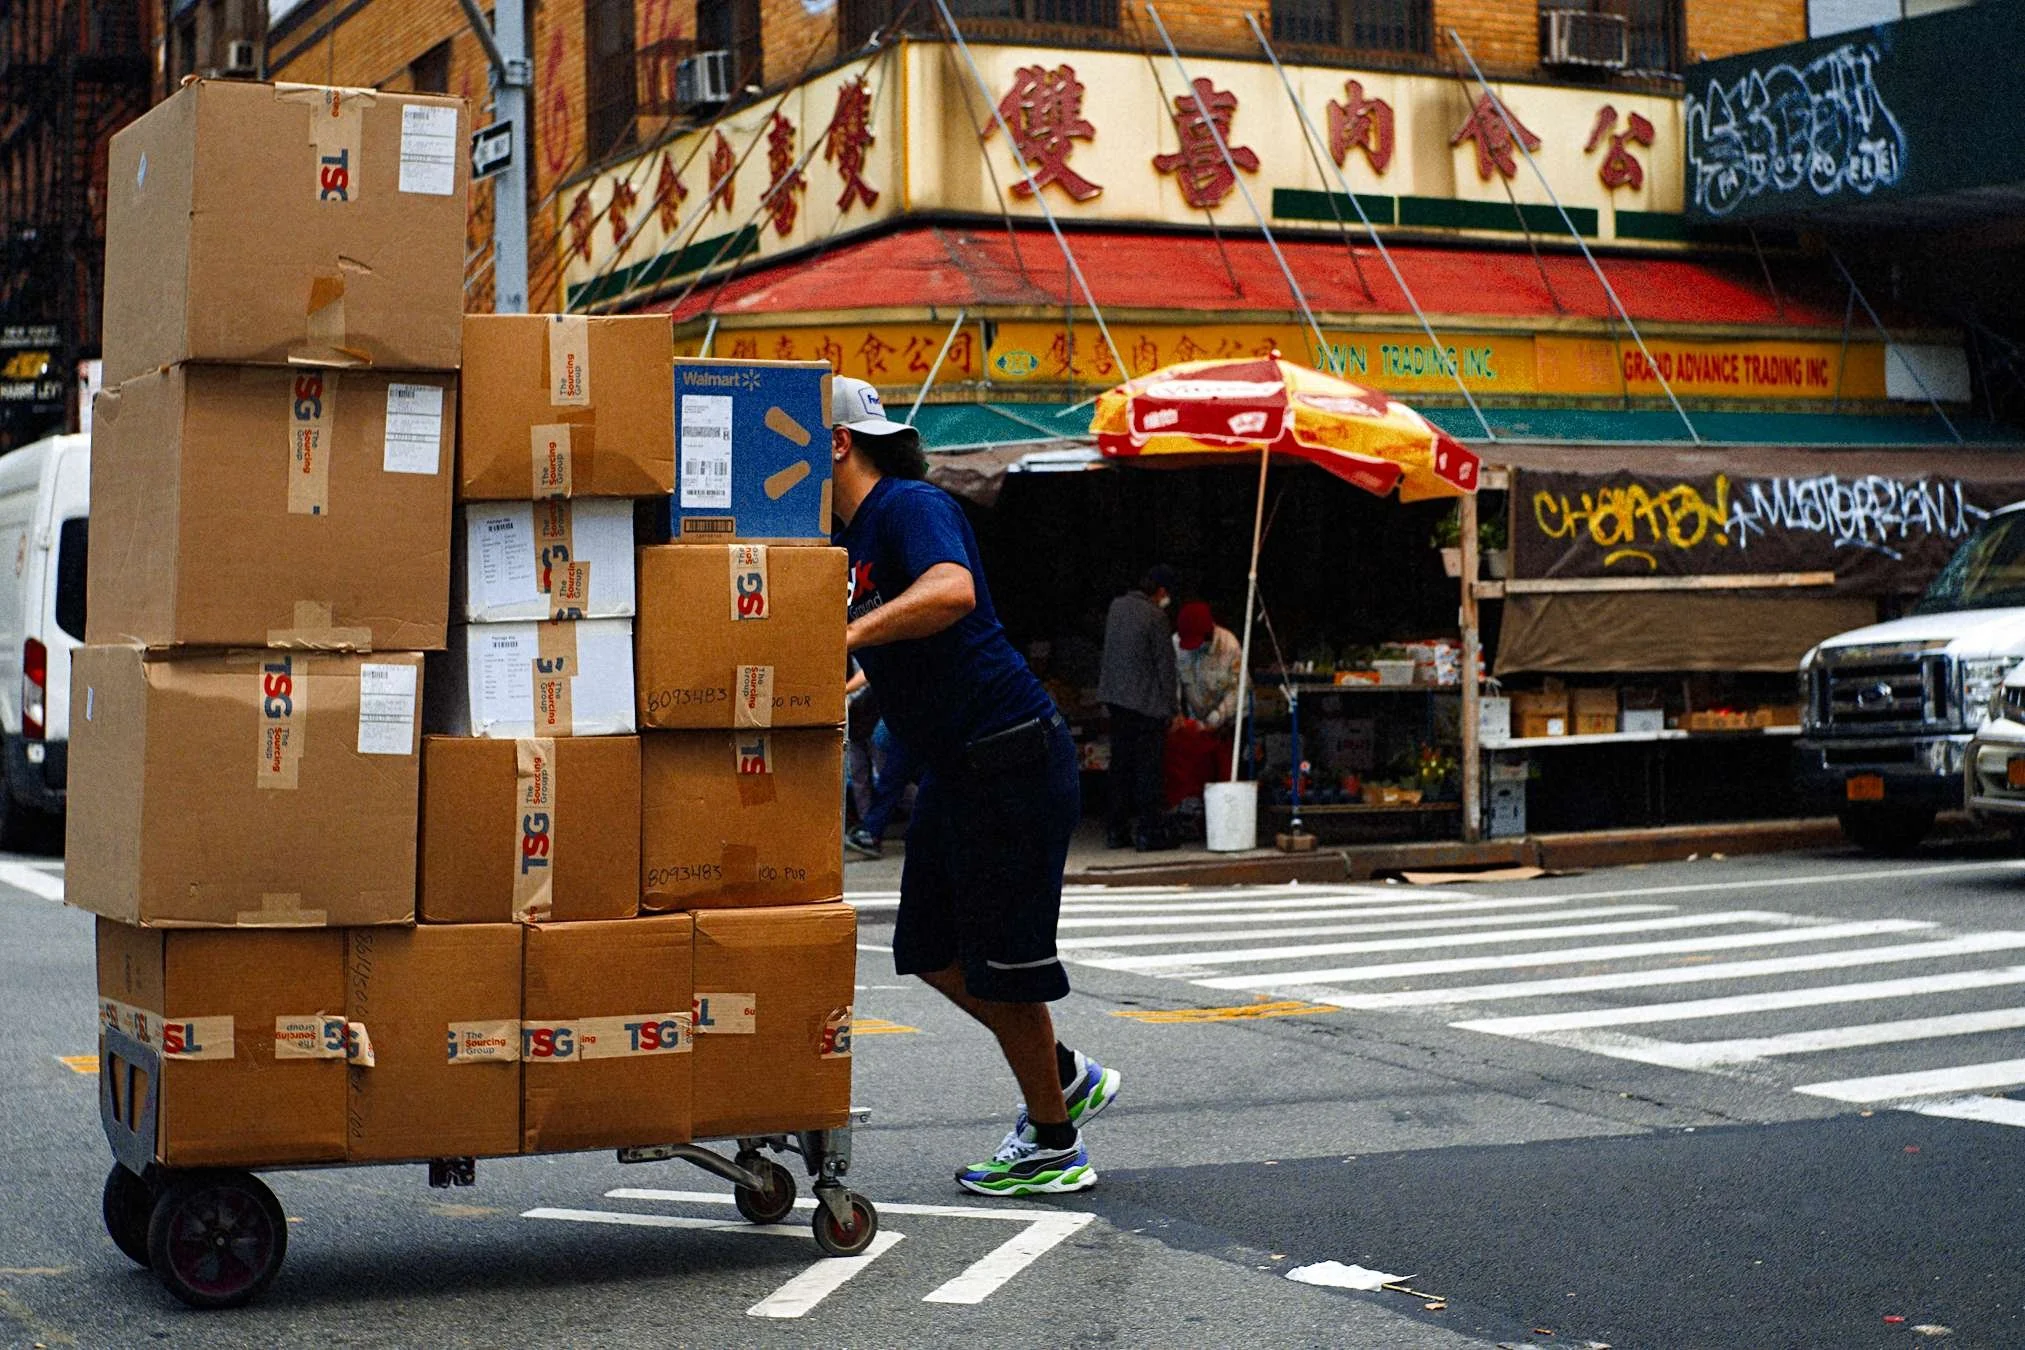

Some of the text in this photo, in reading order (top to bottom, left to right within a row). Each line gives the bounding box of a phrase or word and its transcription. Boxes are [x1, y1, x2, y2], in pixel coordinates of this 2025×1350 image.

[567, 354, 575, 397] Sourcing
[1380, 343, 1458, 378] TRADING
[1623, 350, 1673, 383] GRAND
[1676, 352, 1739, 385] ADVANCE
[1743, 354, 1802, 388] TRADING
[1806, 356, 1829, 388] INC
[683, 371, 740, 387] Walmart
[296, 429, 304, 461] Group
[303, 428, 312, 474] Sourcing
[312, 429, 320, 449] The
[541, 466, 549, 485] The
[549, 441, 557, 486] Sourcing
[567, 562, 576, 600] Sourcin
[574, 568, 583, 599] Group
[264, 655, 293, 719] TSG
[742, 667, 751, 697] Group
[748, 666, 759, 709] Sourcing
[757, 667, 765, 685] The
[540, 682, 548, 713] Group
[547, 681, 557, 725] Sourcing
[265, 727, 275, 759] Group
[272, 727, 283, 773] Sourcing
[281, 727, 290, 747] The
[741, 738, 767, 774] TS
[533, 757, 542, 805] Sourcing
[541, 769, 549, 804] Group
[521, 812, 550, 875] TSG
[274, 1031, 317, 1041] Sourcing
[286, 1023, 316, 1032] Group
[465, 1031, 483, 1040] The
[465, 1037, 507, 1049] Sourcing
[522, 1027, 573, 1057] TSG
[624, 1021, 678, 1051] TSG
[821, 1025, 851, 1054] SG
[466, 1047, 496, 1056] Group
